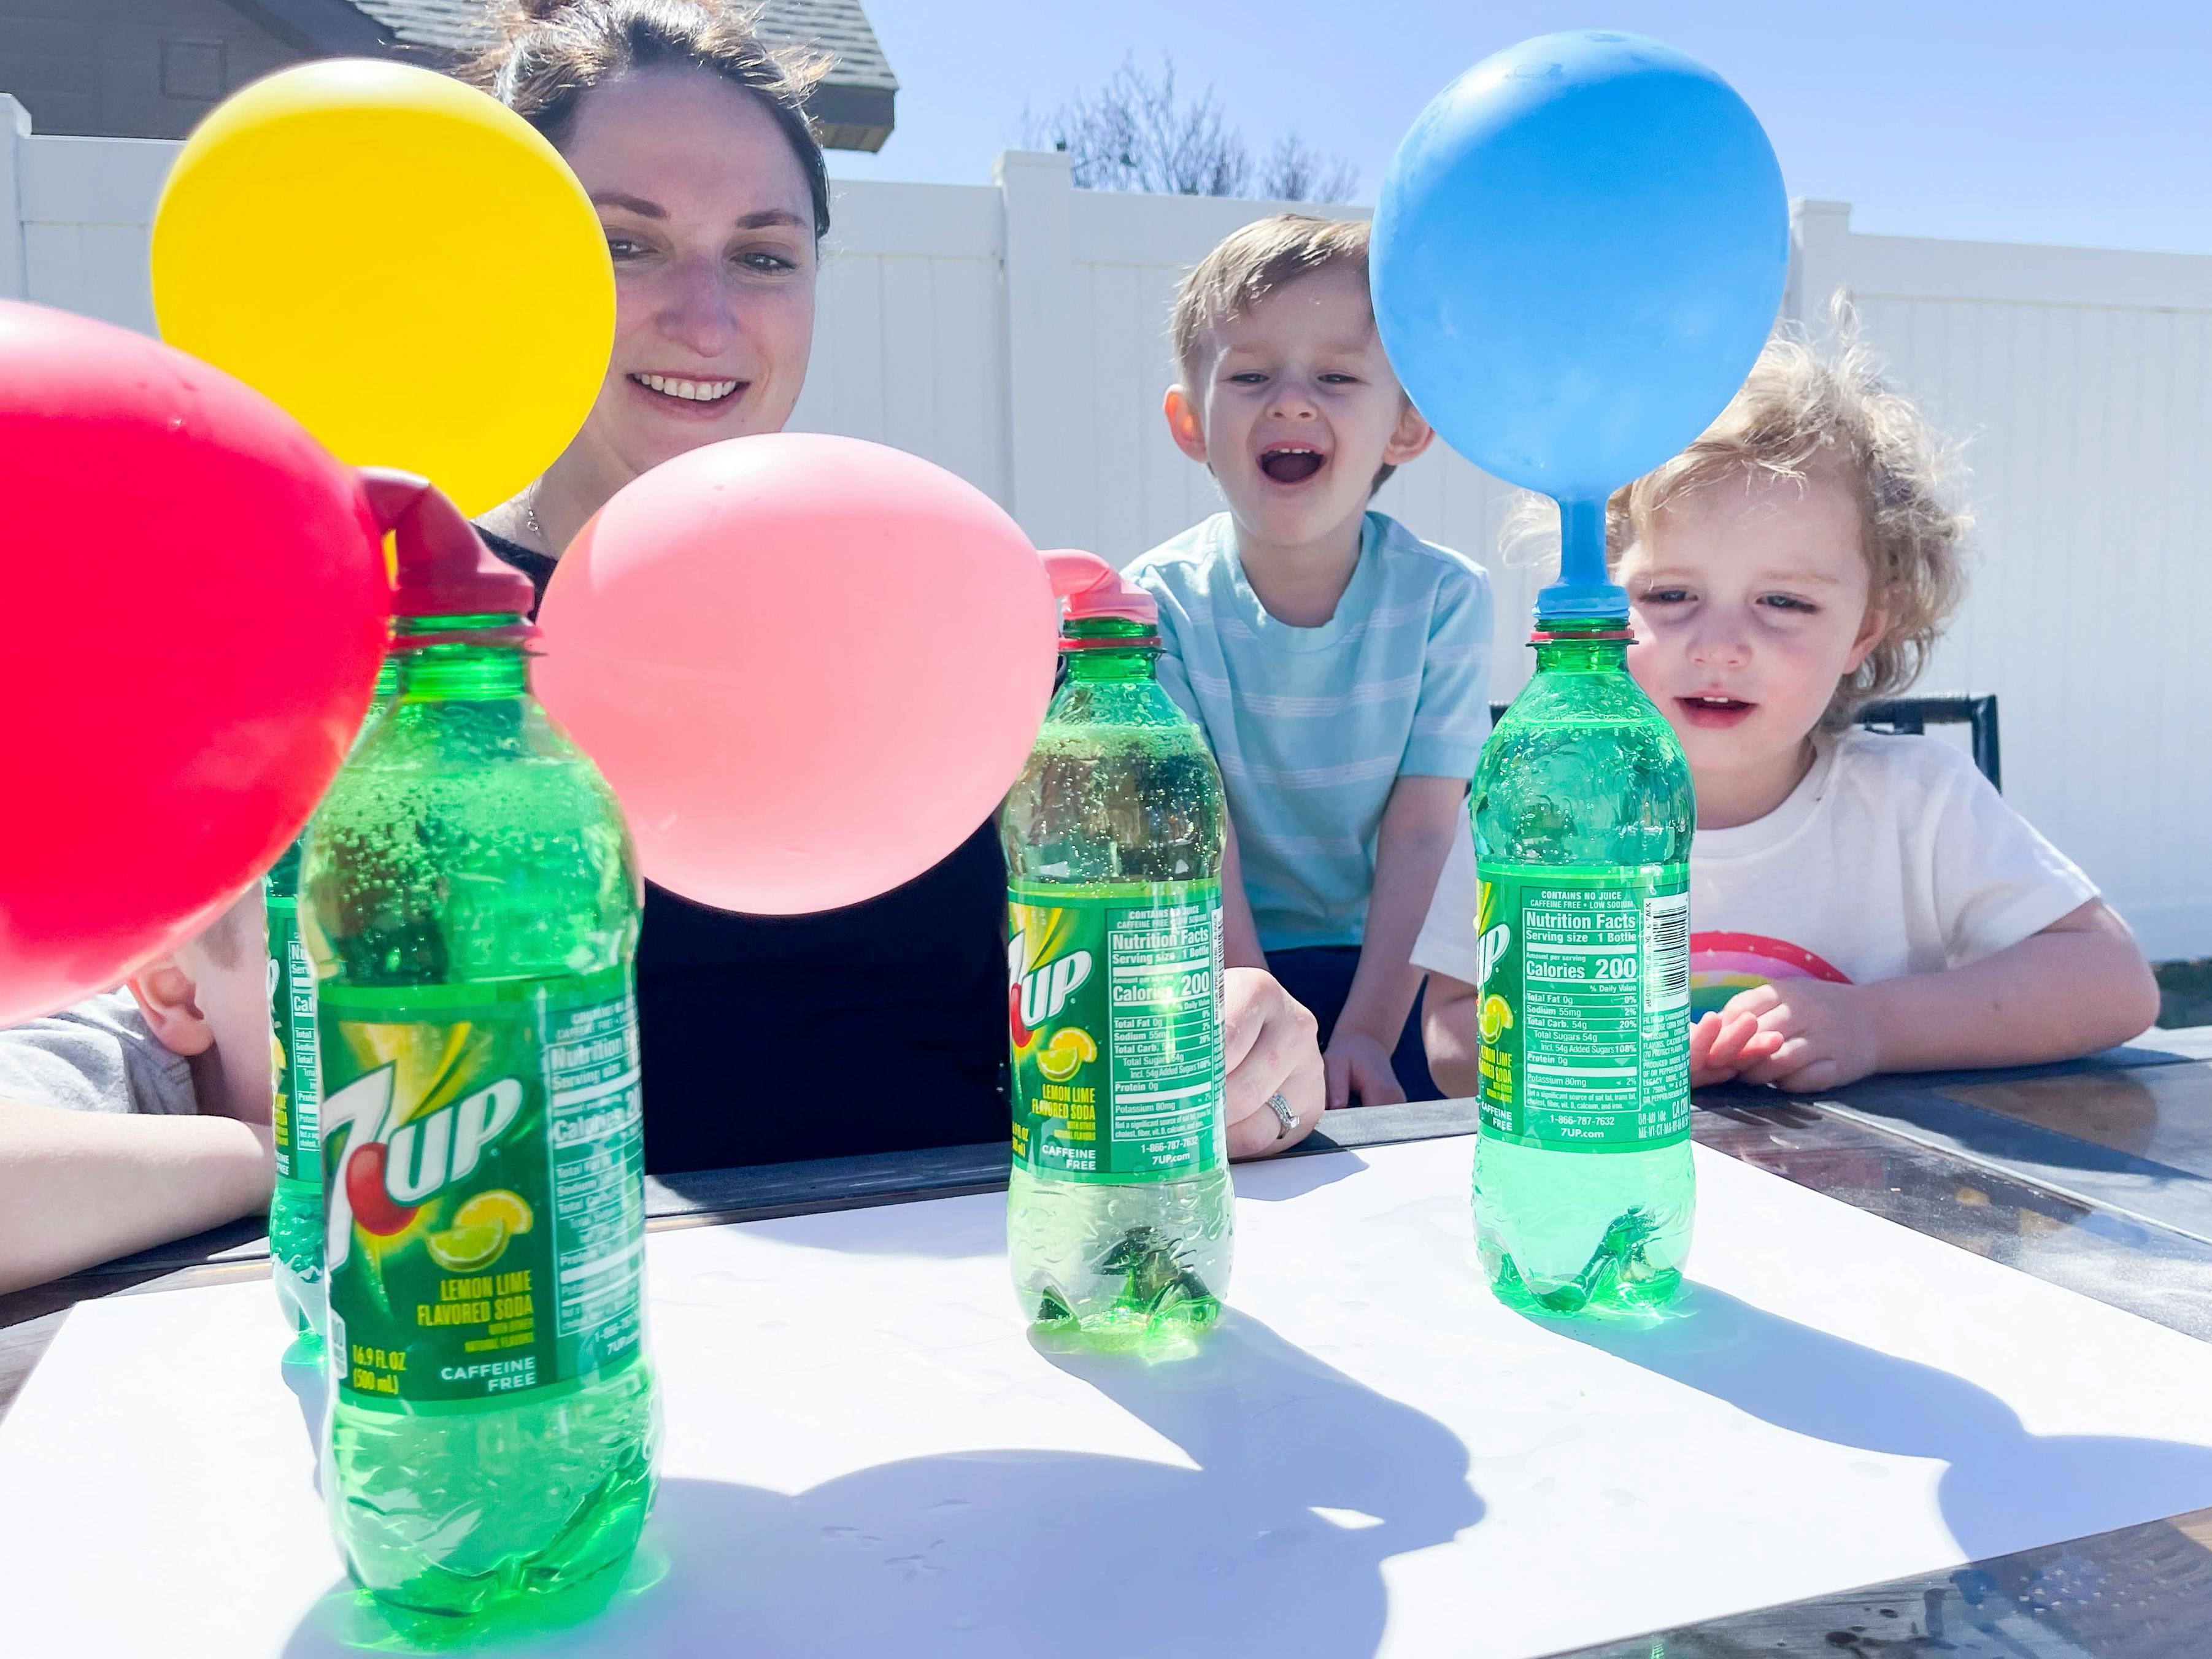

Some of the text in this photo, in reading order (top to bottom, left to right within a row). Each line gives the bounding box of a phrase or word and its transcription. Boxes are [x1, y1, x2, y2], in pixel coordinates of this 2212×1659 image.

[1541, 891, 1581, 899] CONTAINS
[1129, 909, 1168, 919] CONTAINS
[1527, 911, 1636, 929] Nutrition Facts
[1117, 920, 1150, 928] CAFFEINE
[1112, 927, 1208, 950] Nutrition Facts
[1526, 930, 1636, 943] Serving size 1 Bottle
[1112, 946, 1209, 964] Serving size 1 Bottle
[1527, 958, 1636, 979] Calories 200
[1113, 985, 1173, 1001] Calories
[1181, 971, 1209, 995] 200
[1599, 985, 1617, 993] Daily
[1527, 993, 1544, 1002] Total
[1547, 995, 1560, 1003] Fat
[1563, 996, 1573, 1005] 0g
[1527, 1006, 1556, 1015] Sodium
[1559, 1008, 1581, 1017] 55mg
[1114, 1020, 1135, 1028] Total
[1153, 1019, 1163, 1028] 0g
[1527, 1017, 1545, 1026] Total
[1547, 1019, 1569, 1028] Carb.
[1572, 1020, 1587, 1030] 54g
[1114, 1032, 1146, 1041] Sodium
[1535, 1030, 1598, 1042] Total Sugars 54g
[1114, 1045, 1135, 1053] Total
[1138, 1044, 1158, 1053] Carb.
[1555, 1045, 1568, 1053] 54g
[1592, 1045, 1615, 1054] Sugars
[1123, 1057, 1141, 1066] Total
[1496, 1045, 1512, 1068] LIME
[1527, 1053, 1568, 1066] Protein 0g
[1130, 1070, 1144, 1079] Incl.
[1146, 1069, 1159, 1079] 54g
[1495, 1066, 1513, 1085] SODA
[1527, 1074, 1563, 1085] Potassium
[1565, 1077, 1587, 1087] 80mg
[1115, 1082, 1158, 1091] Protein 0g
[1042, 1084, 1095, 1103] LEMON LIME
[1541, 1091, 1568, 1101] significant
[1031, 1098, 1095, 1120] FLAVORED SODA
[1115, 1104, 1154, 1114] Potassium
[1156, 1102, 1175, 1111] 80mg
[1481, 1101, 1513, 1121] CAFFEINE
[1577, 1101, 1599, 1109] calcium,
[553, 1107, 625, 1142] Calories
[1492, 1117, 1513, 1131] FREE
[1551, 1114, 1615, 1125] 1-866-787-7632
[1561, 1128, 1604, 1137] 7UP.com
[1141, 1137, 1198, 1153] 1-866-787-7632
[1042, 1145, 1096, 1159] CAFFEINE
[1153, 1152, 1190, 1164] 7UP.com
[1066, 1160, 1096, 1170] FREE
[441, 1269, 531, 1301] LEMON LIME
[417, 1301, 490, 1325] FLAVORED
[494, 1295, 533, 1320] SODA
[375, 1349, 388, 1369] FL
[389, 1352, 406, 1371] OZ
[441, 1356, 536, 1380] CAFFEINE
[488, 1372, 536, 1391] FREE
